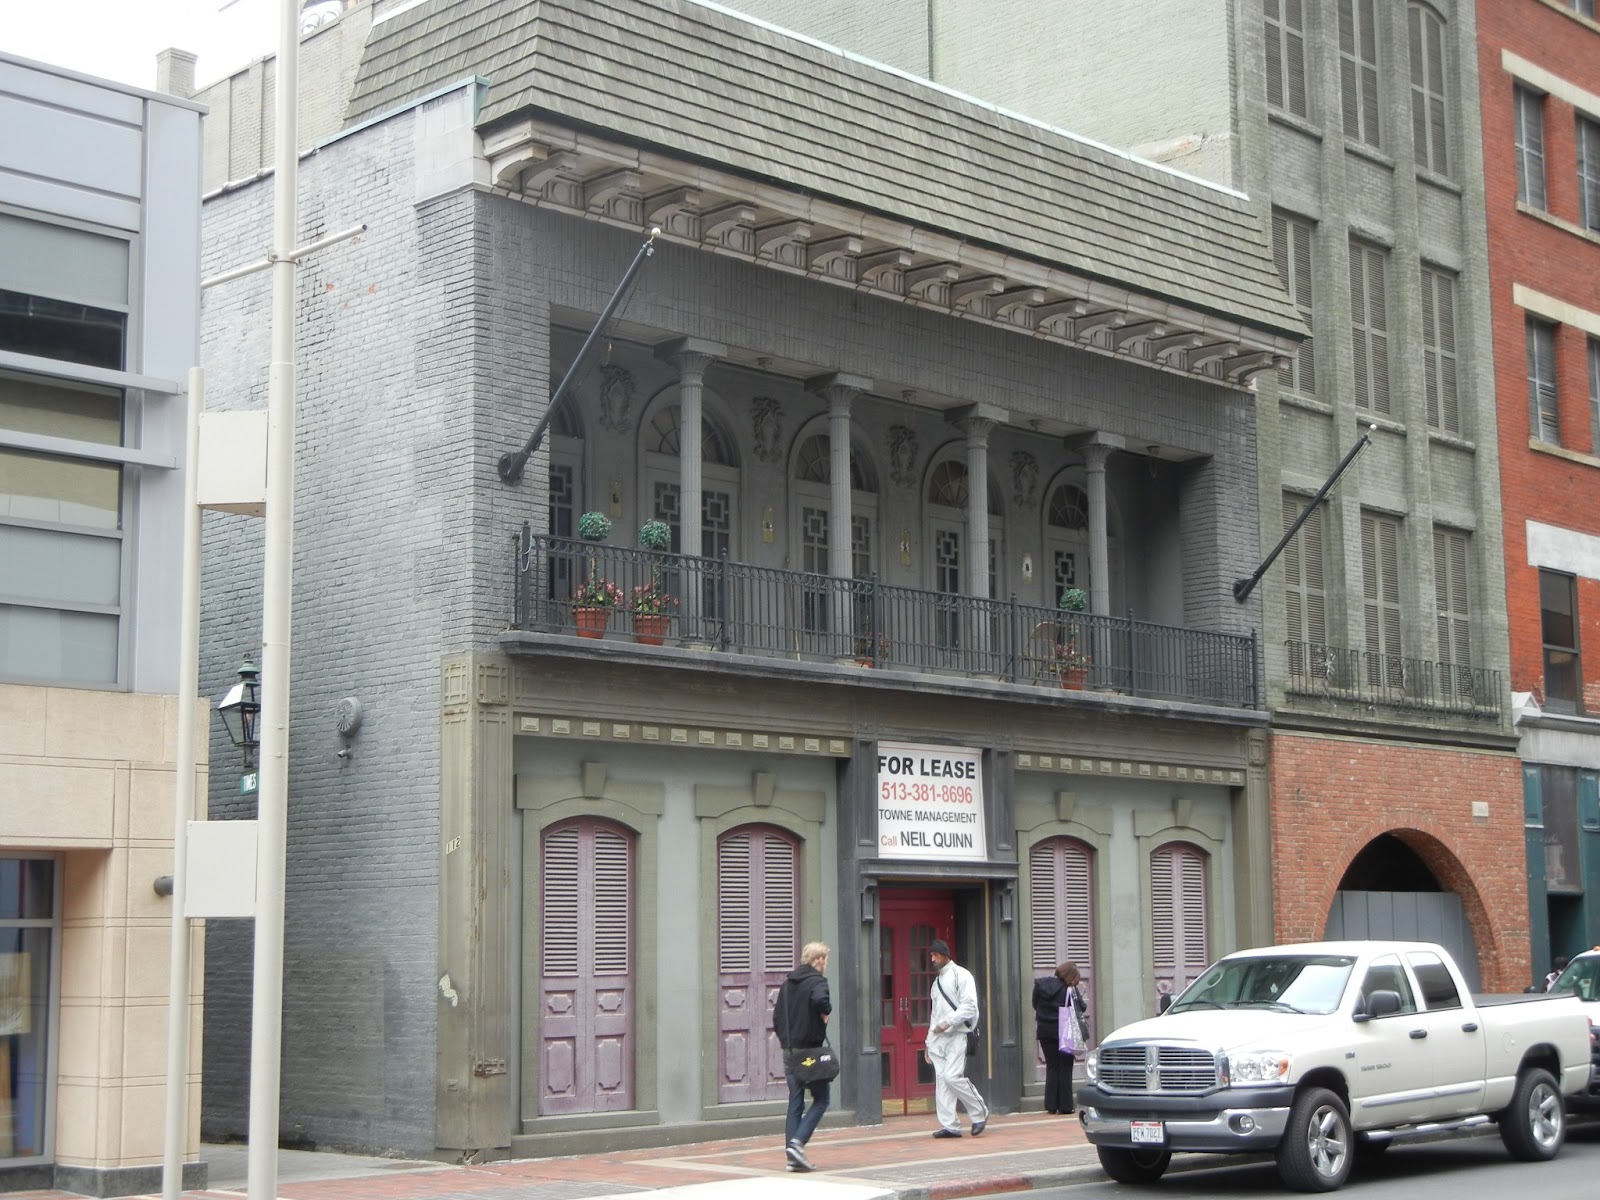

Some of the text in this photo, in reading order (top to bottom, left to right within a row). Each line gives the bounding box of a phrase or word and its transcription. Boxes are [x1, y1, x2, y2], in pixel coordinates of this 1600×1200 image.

[878, 756, 976, 779] FOR LEASE
[882, 781, 973, 804] 513-381-8696
[879, 809, 977, 824] TOWNE MANAGEMENT
[447, 837, 460, 853] 112
[881, 831, 973, 848] Call NEIL QUINN
